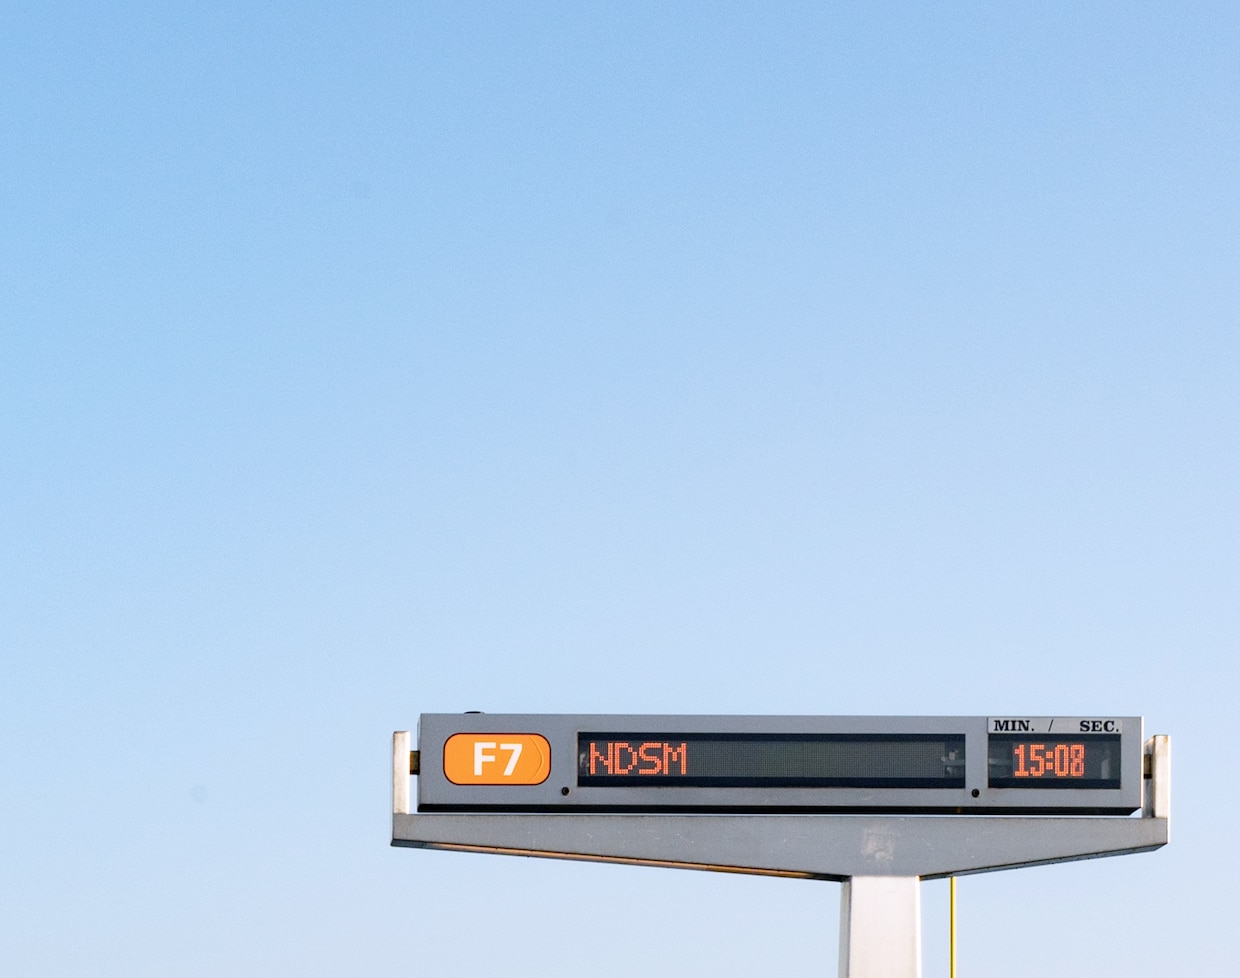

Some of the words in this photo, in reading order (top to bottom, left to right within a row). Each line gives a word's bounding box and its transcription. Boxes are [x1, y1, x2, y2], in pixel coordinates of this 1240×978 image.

[993, 719, 1035, 732] MIN.
[1079, 719, 1120, 733] SEC.
[473, 742, 523, 776] F7
[588, 742, 687, 775] NDSM
[1013, 744, 1086, 777] 15:08
